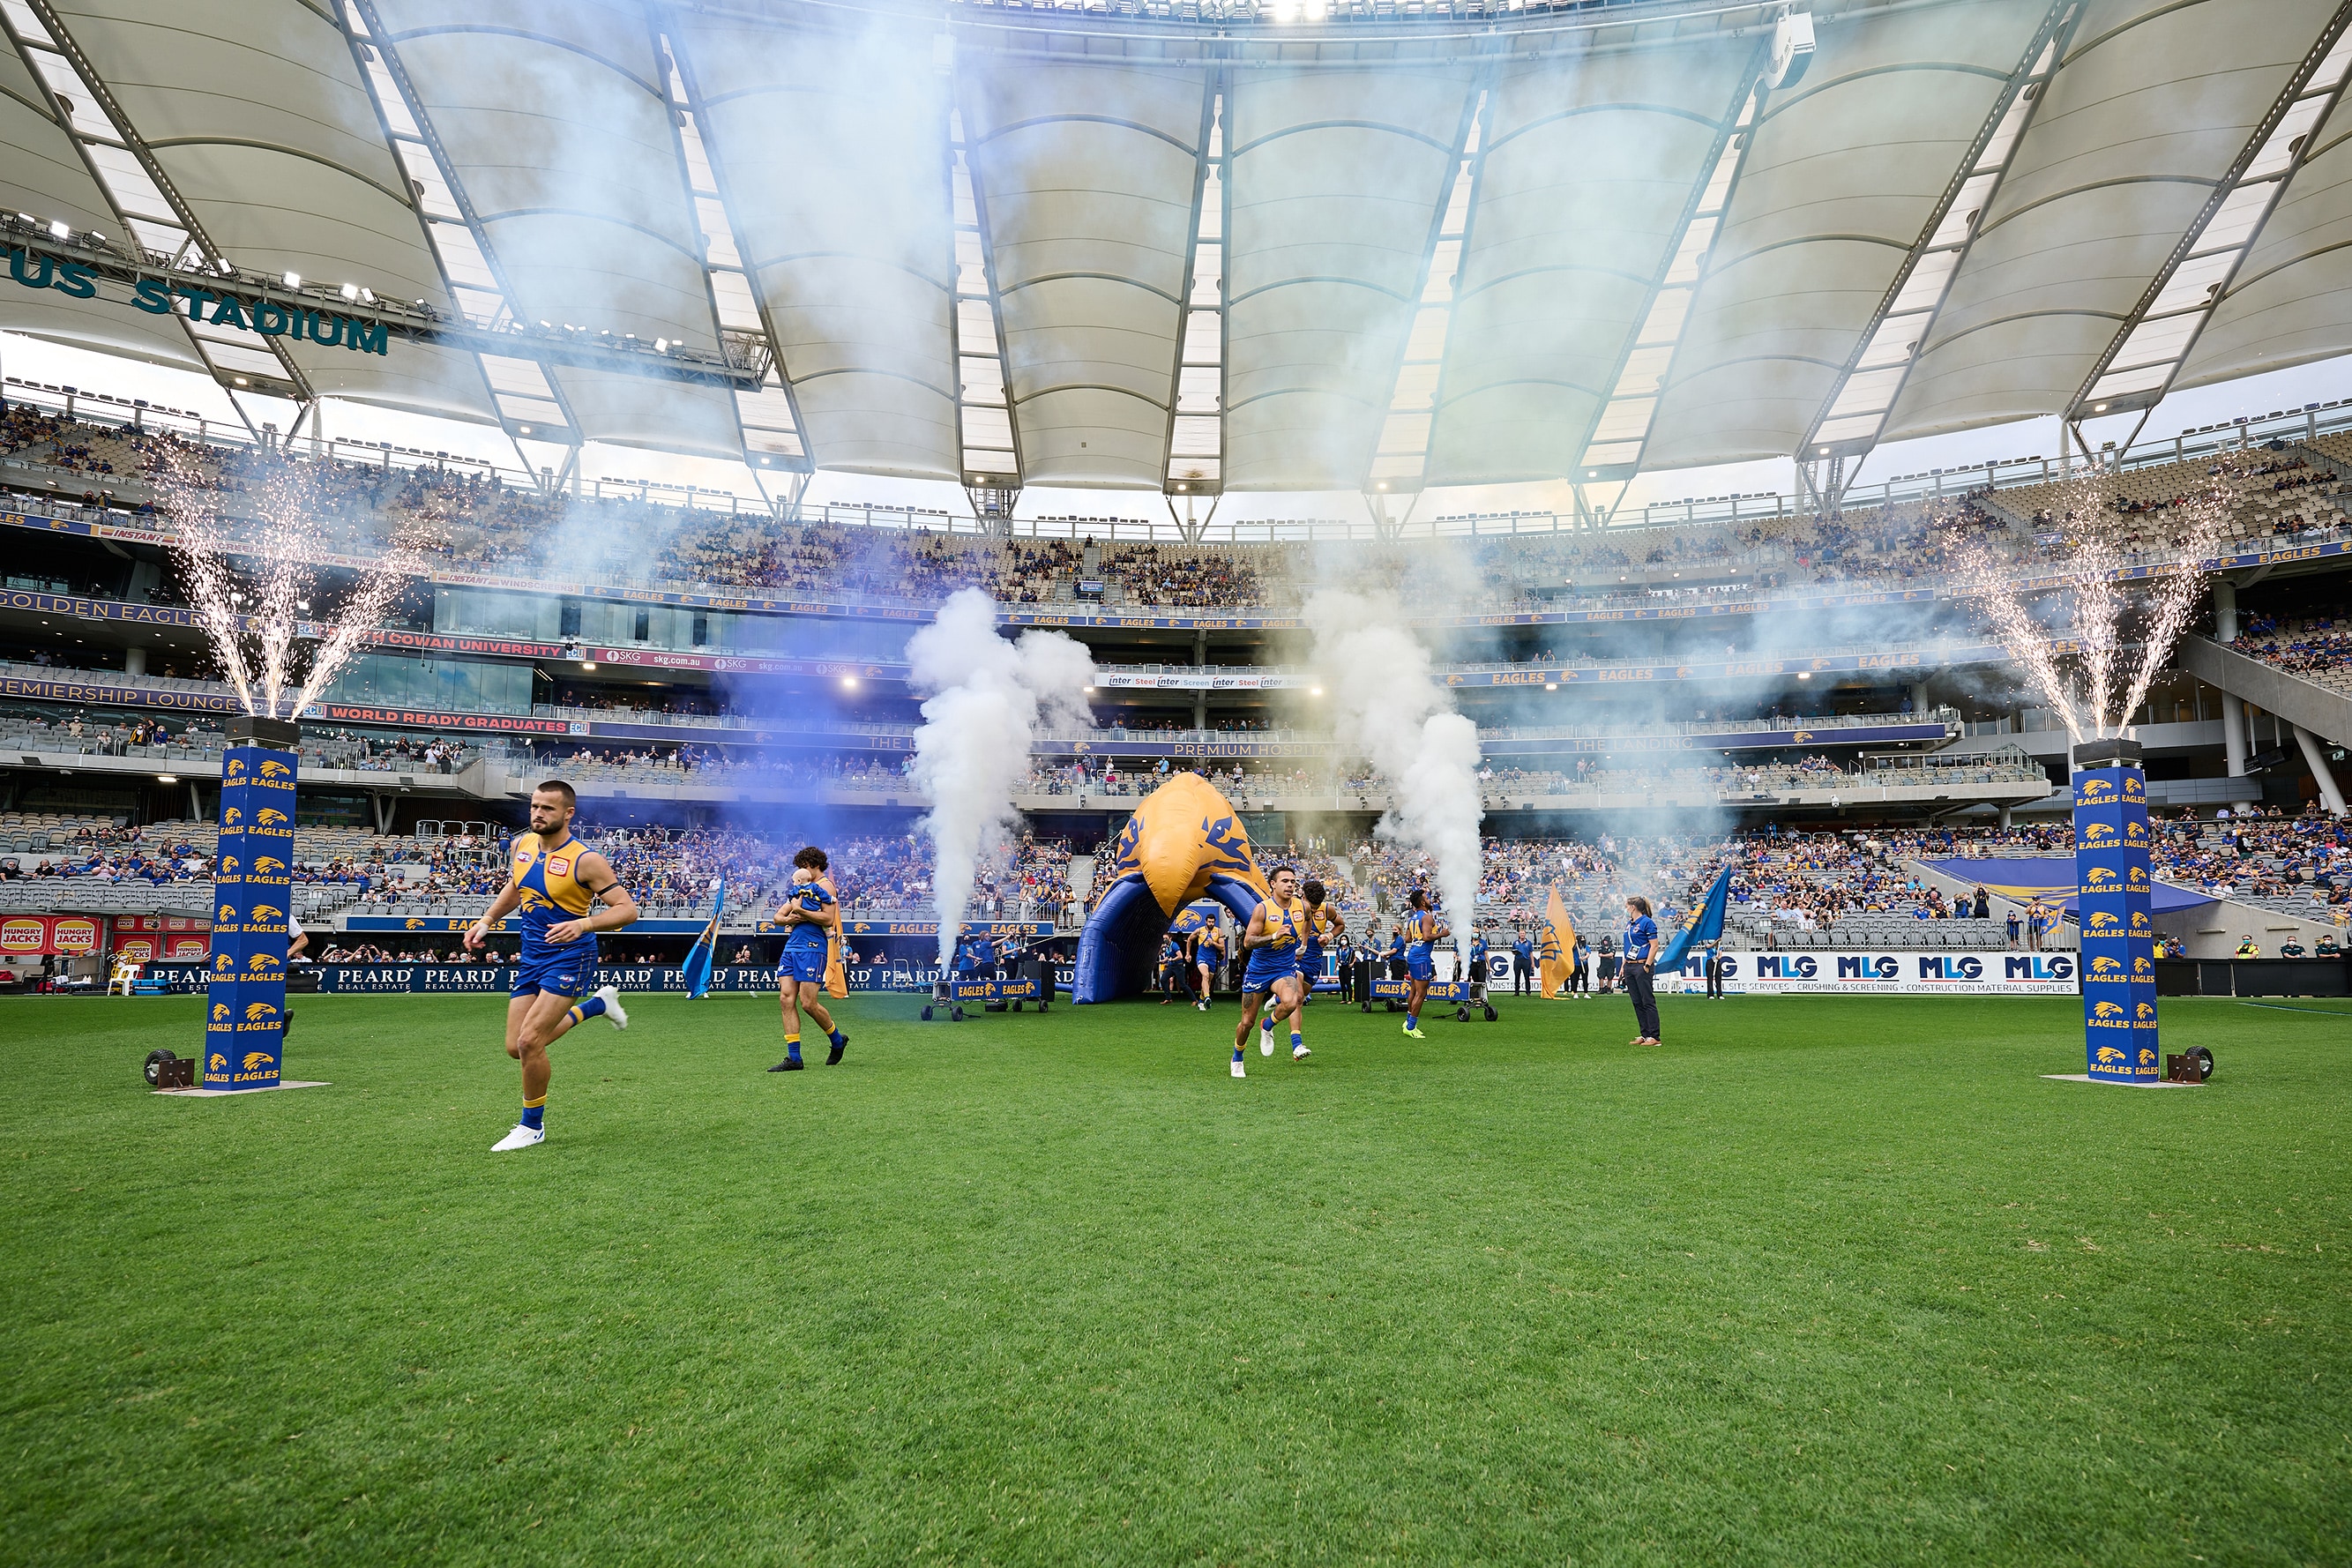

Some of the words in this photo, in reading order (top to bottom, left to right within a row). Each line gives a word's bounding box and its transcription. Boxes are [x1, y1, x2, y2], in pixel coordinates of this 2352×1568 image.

[0, 248, 98, 298] US
[131, 280, 387, 355] STADIUM
[2259, 547, 2320, 563] EAGLES
[348, 558, 429, 573] WINDSEENS
[449, 575, 489, 585] INSTANT
[500, 579, 573, 592] WINDSCREENS
[2029, 575, 2077, 588] EAGLES
[623, 591, 664, 601] EAGLES
[1844, 594, 1886, 605] EAGLES
[708, 599, 748, 608] EAGLES
[790, 603, 828, 613] EAGLES
[1729, 602, 1770, 613] EAGLES
[122, 606, 212, 627] EAGLE
[882, 609, 919, 618] EAGLES
[1587, 611, 1624, 620] EAGLES
[1658, 608, 1696, 617] EAGLES
[1479, 616, 1516, 624] EAGLES
[389, 633, 454, 650] COWAN
[459, 639, 561, 657] UNIVERSITY
[566, 648, 584, 658] ECU
[619, 651, 641, 661] SKG
[653, 655, 700, 666] skg.com.au
[727, 659, 747, 668] SKG
[1858, 653, 1920, 668] EAGLES
[758, 661, 803, 672] skg.com.au
[827, 664, 847, 675] SKG
[1726, 661, 1783, 676] EAGLES
[1491, 673, 1545, 684] EAGLES
[1599, 668, 1653, 681] EAGLES
[1109, 675, 1131, 686] inter
[1157, 676, 1179, 687] inter
[1213, 676, 1235, 688] inter
[1260, 676, 1282, 688] inter
[0, 679, 138, 704] EMIERSHIP
[146, 691, 236, 711] LOUNGE
[332, 707, 398, 722] WORLD
[404, 712, 462, 726] READY
[465, 716, 566, 732] GRADUATES
[570, 722, 587, 733] ECU
[869, 736, 901, 749] THE
[1573, 740, 1606, 750] THE
[1614, 737, 1693, 750] LANDING
[1175, 744, 1251, 756] PREMIUM
[222, 776, 247, 788] EAGLES
[250, 777, 295, 791] EAGLES
[2076, 795, 2118, 807] EAGLES
[2121, 795, 2146, 804] EAGLES
[220, 825, 244, 835] EAGLES
[248, 825, 293, 838] EAGLES
[2079, 839, 2120, 850] EAGLES
[2124, 839, 2148, 849] EAGLES
[217, 874, 242, 884] EAGLES
[245, 874, 290, 885] EAGLES
[2080, 884, 2123, 893] EAGLES
[2125, 884, 2150, 893] EAGLES
[213, 923, 238, 933] EAGLES
[243, 923, 287, 933] EAGLES
[448, 920, 507, 931] EAGES
[890, 924, 937, 934] EAGLES
[991, 924, 1038, 934] EAGLES
[1409, 920, 1423, 940] 14
[4, 934, 41, 943] JACK'S
[2128, 930, 2152, 938] EAGLES
[1758, 956, 1818, 978] MLG
[1838, 956, 1899, 978] MLG
[1920, 956, 1983, 978] MLG
[2005, 956, 2073, 978] MLG
[153, 970, 210, 982] PEAR
[211, 973, 235, 982] EAGLES
[239, 973, 285, 982] EAGLES
[338, 970, 411, 982] PEARD
[425, 970, 496, 982] PEARD
[664, 970, 726, 982] PED
[2085, 974, 2127, 983] EAGLES
[2130, 974, 2154, 983] EAGLES
[959, 986, 984, 997] EAGLES
[1003, 984, 1025, 995] EAGLES
[1375, 983, 1400, 994] EAGLES
[1426, 986, 1446, 997] GLES
[207, 1023, 232, 1033] EAGLES
[236, 1021, 282, 1032] EAGLES
[2087, 1019, 2130, 1028] EAGLES
[2132, 1020, 2157, 1029] EAGLES
[2089, 1064, 2132, 1075] EAGLES
[2135, 1066, 2159, 1075] EAGLES
[205, 1072, 229, 1083] EAGLES
[234, 1070, 280, 1083] EAGLES
